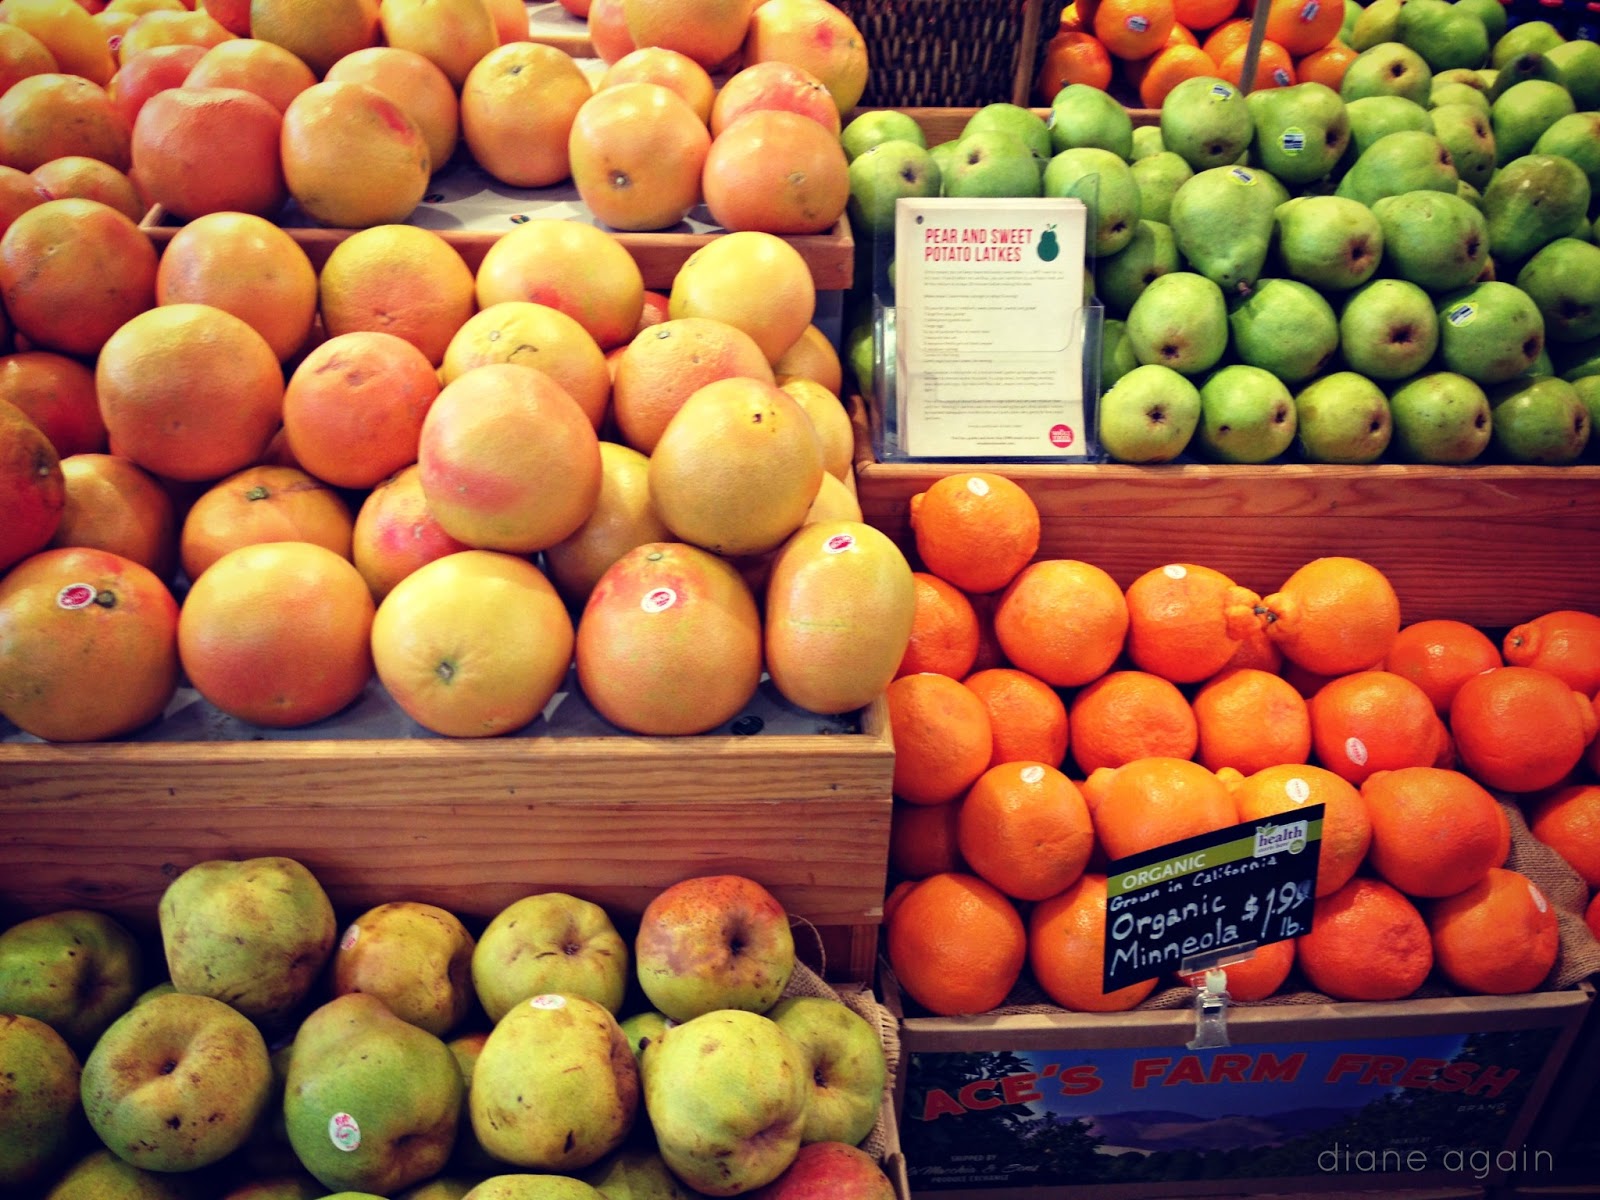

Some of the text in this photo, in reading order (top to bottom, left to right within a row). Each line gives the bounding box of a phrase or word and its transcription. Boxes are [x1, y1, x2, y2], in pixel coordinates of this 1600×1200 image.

[924, 246, 1022, 262] POTATO LATKES
[925, 228, 1033, 244] PEAR AND SWEET
[1259, 825, 1303, 847] health
[1110, 856, 1278, 912] Grown in California
[1122, 853, 1207, 890] ORGANIC
[1112, 894, 1227, 940] Organic
[1110, 917, 1239, 977] Minneola
[923, 1053, 1520, 1121] ACE'S FARM FRESH
